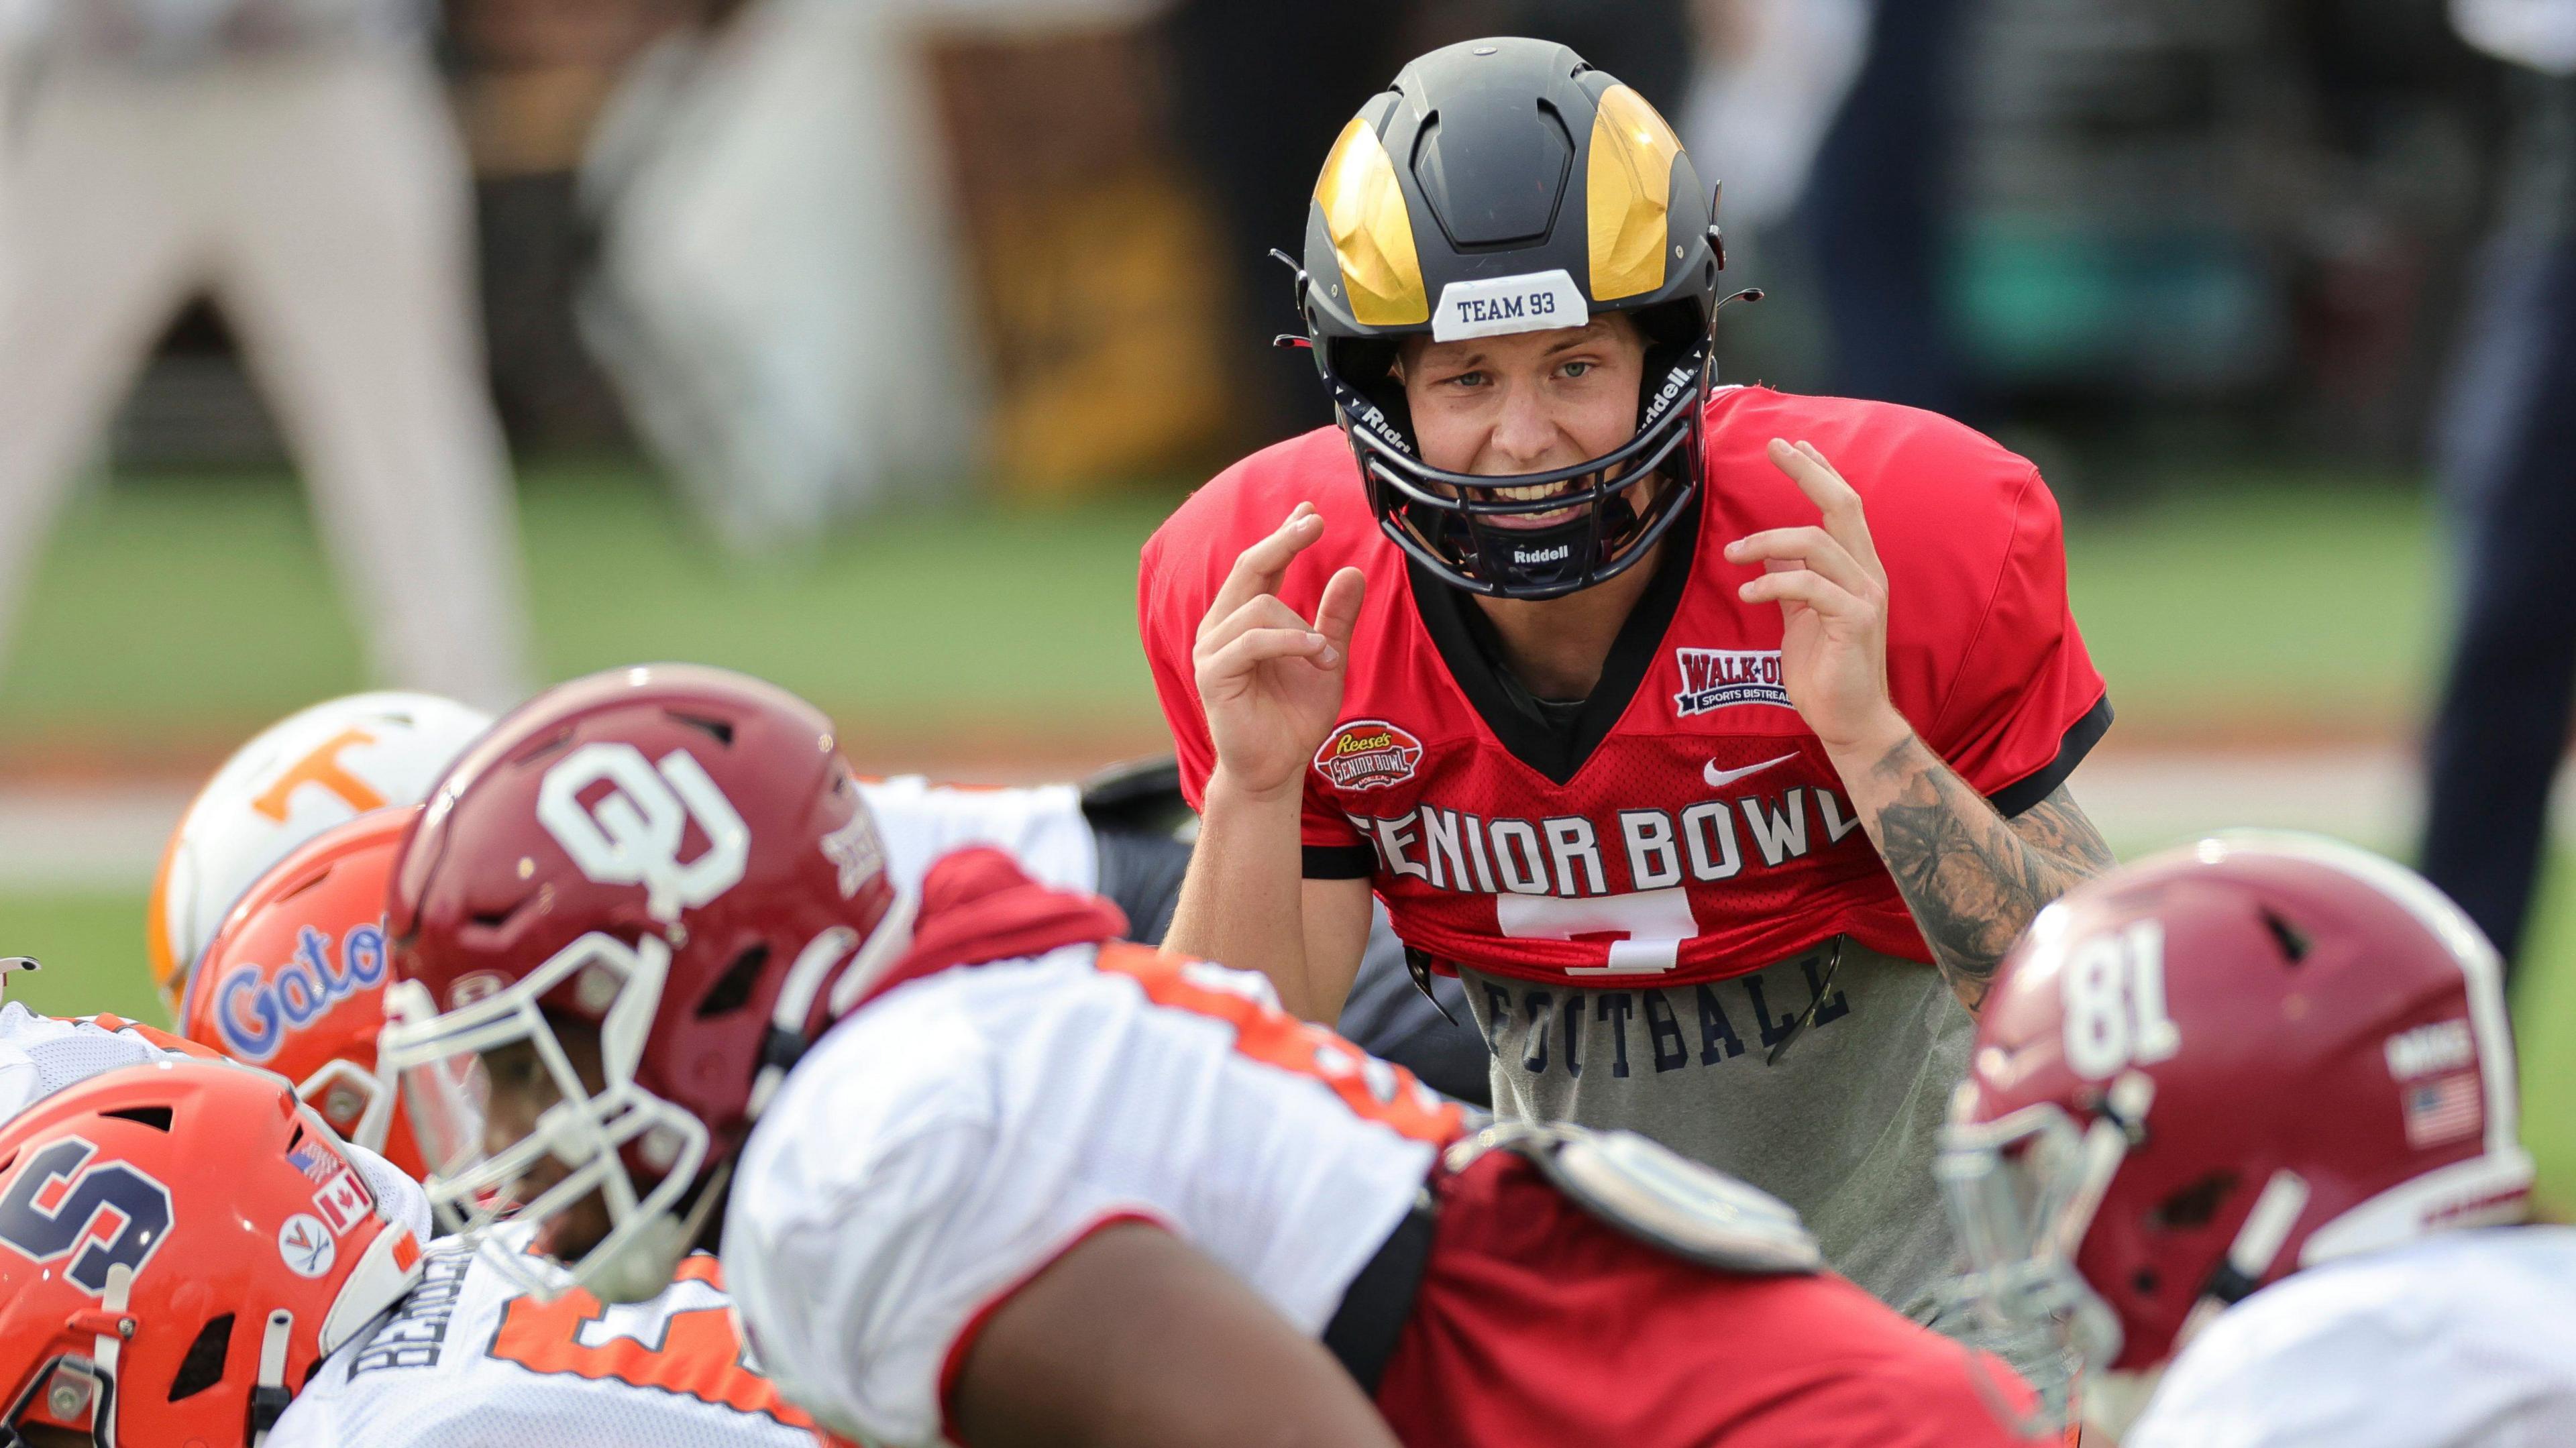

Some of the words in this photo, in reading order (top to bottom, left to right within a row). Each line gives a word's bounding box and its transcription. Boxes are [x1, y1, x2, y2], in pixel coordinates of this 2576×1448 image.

[1457, 296, 1524, 323] TEAM
[1529, 292, 1555, 315] 93
[1514, 545, 1568, 563] Riddell
[1702, 691, 1741, 706] SPORTS
[1336, 732, 1391, 755] Reese's
[1334, 755, 1376, 781] SENIOR
[1375, 750, 1409, 772] BOWL
[212, 923, 388, 1061] Gato
[2061, 917, 2180, 1078] 81
[1482, 956, 1849, 1078] FOOTBALL
[0, 1135, 174, 1296] S
